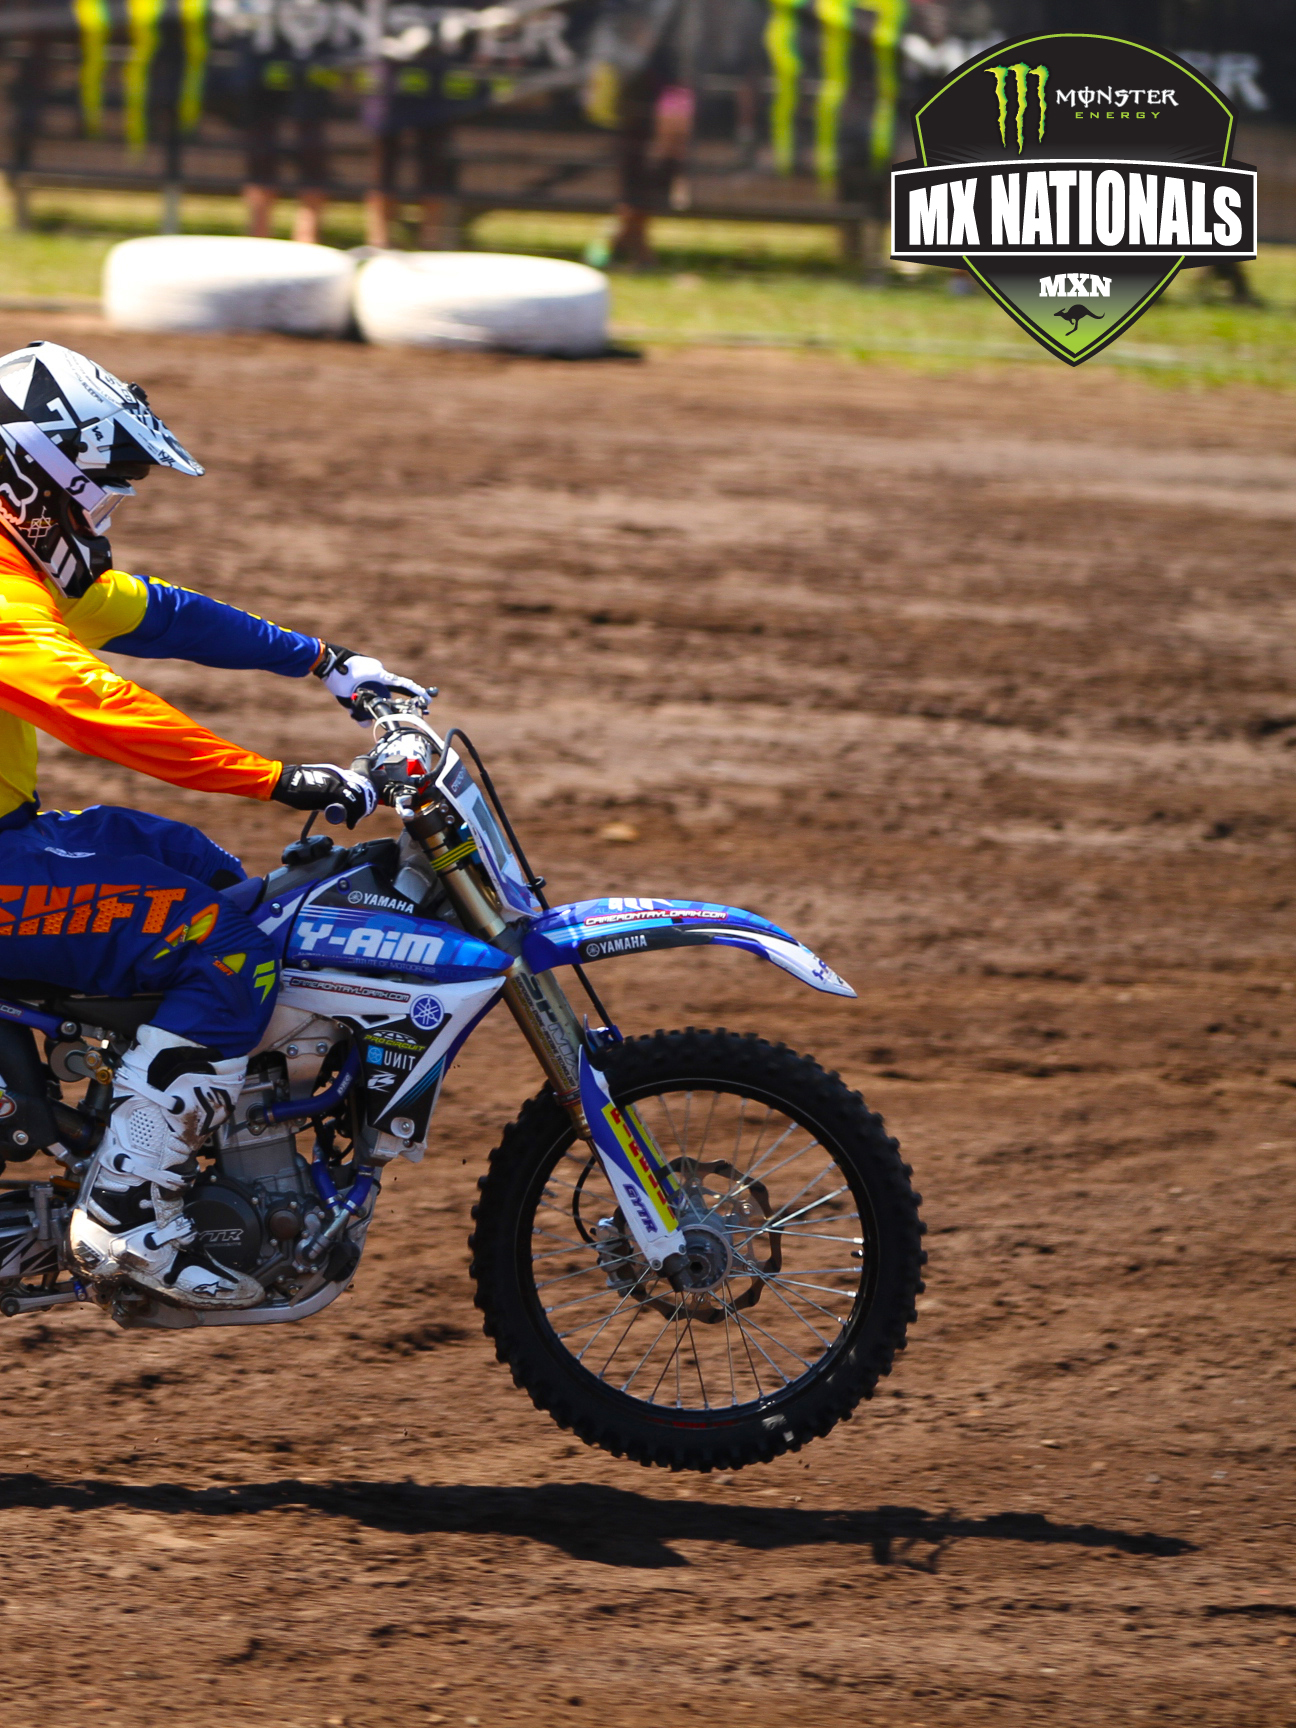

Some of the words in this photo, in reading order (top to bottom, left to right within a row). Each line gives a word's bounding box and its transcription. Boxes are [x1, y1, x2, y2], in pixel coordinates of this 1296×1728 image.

[362, 892, 415, 915] YAMAHA
[599, 933, 648, 954] YAMAHA
[384, 1050, 416, 1071] UNIT
[622, 1183, 658, 1234] GYTR
